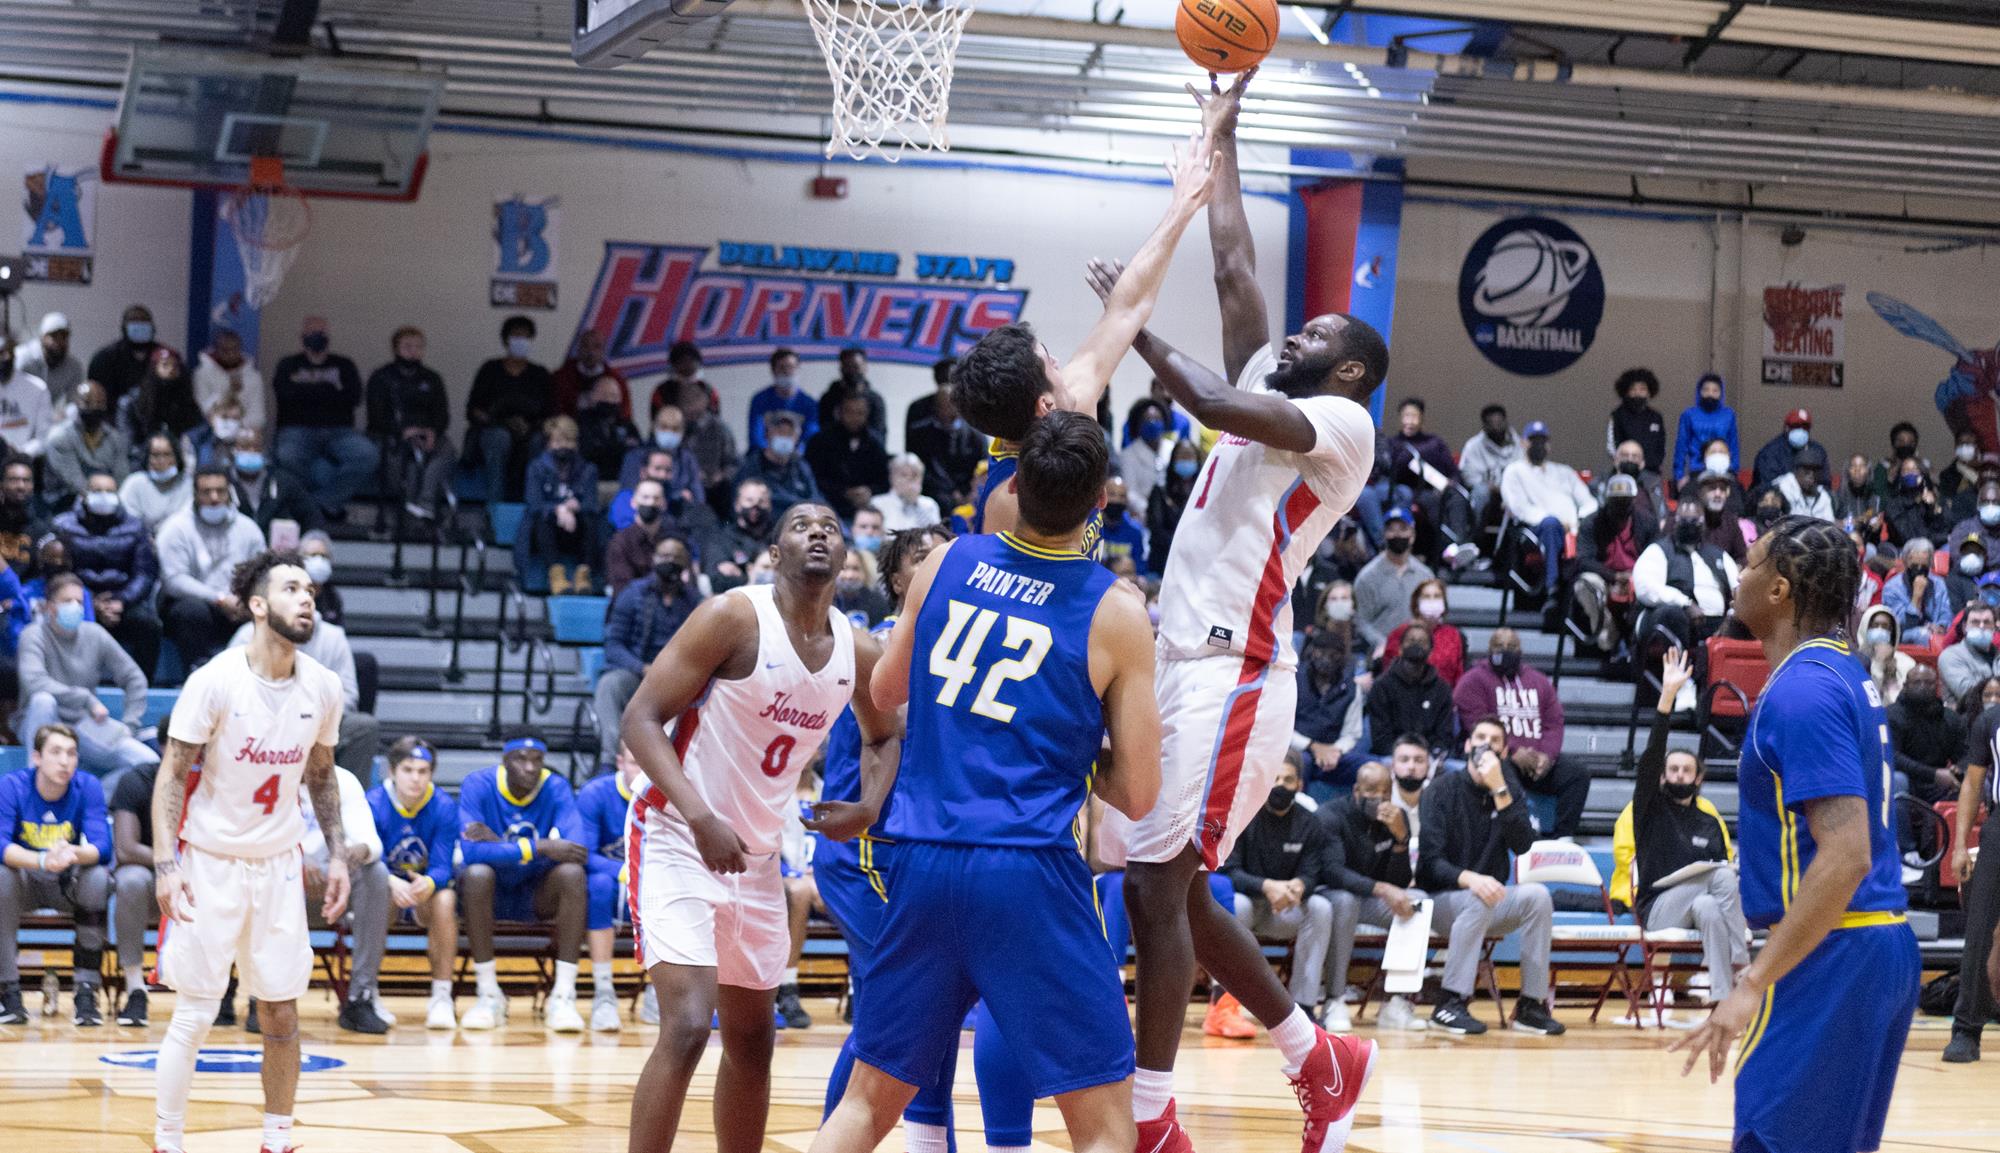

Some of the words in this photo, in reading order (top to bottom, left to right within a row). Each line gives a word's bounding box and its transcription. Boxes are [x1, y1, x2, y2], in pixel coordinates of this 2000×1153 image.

[1196, 0, 1247, 37] ELITE
[719, 241, 900, 276] DELAWARE
[916, 254, 1014, 283] STATE
[1496, 323, 1583, 353] BASKETBALL
[1195, 456, 1219, 510] 1
[966, 561, 1055, 606] PAINTER
[929, 599, 1054, 723] 42
[759, 691, 829, 730] Hornets
[235, 736, 304, 765] Hornets
[761, 734, 796, 777] 0
[253, 774, 280, 815] 4
